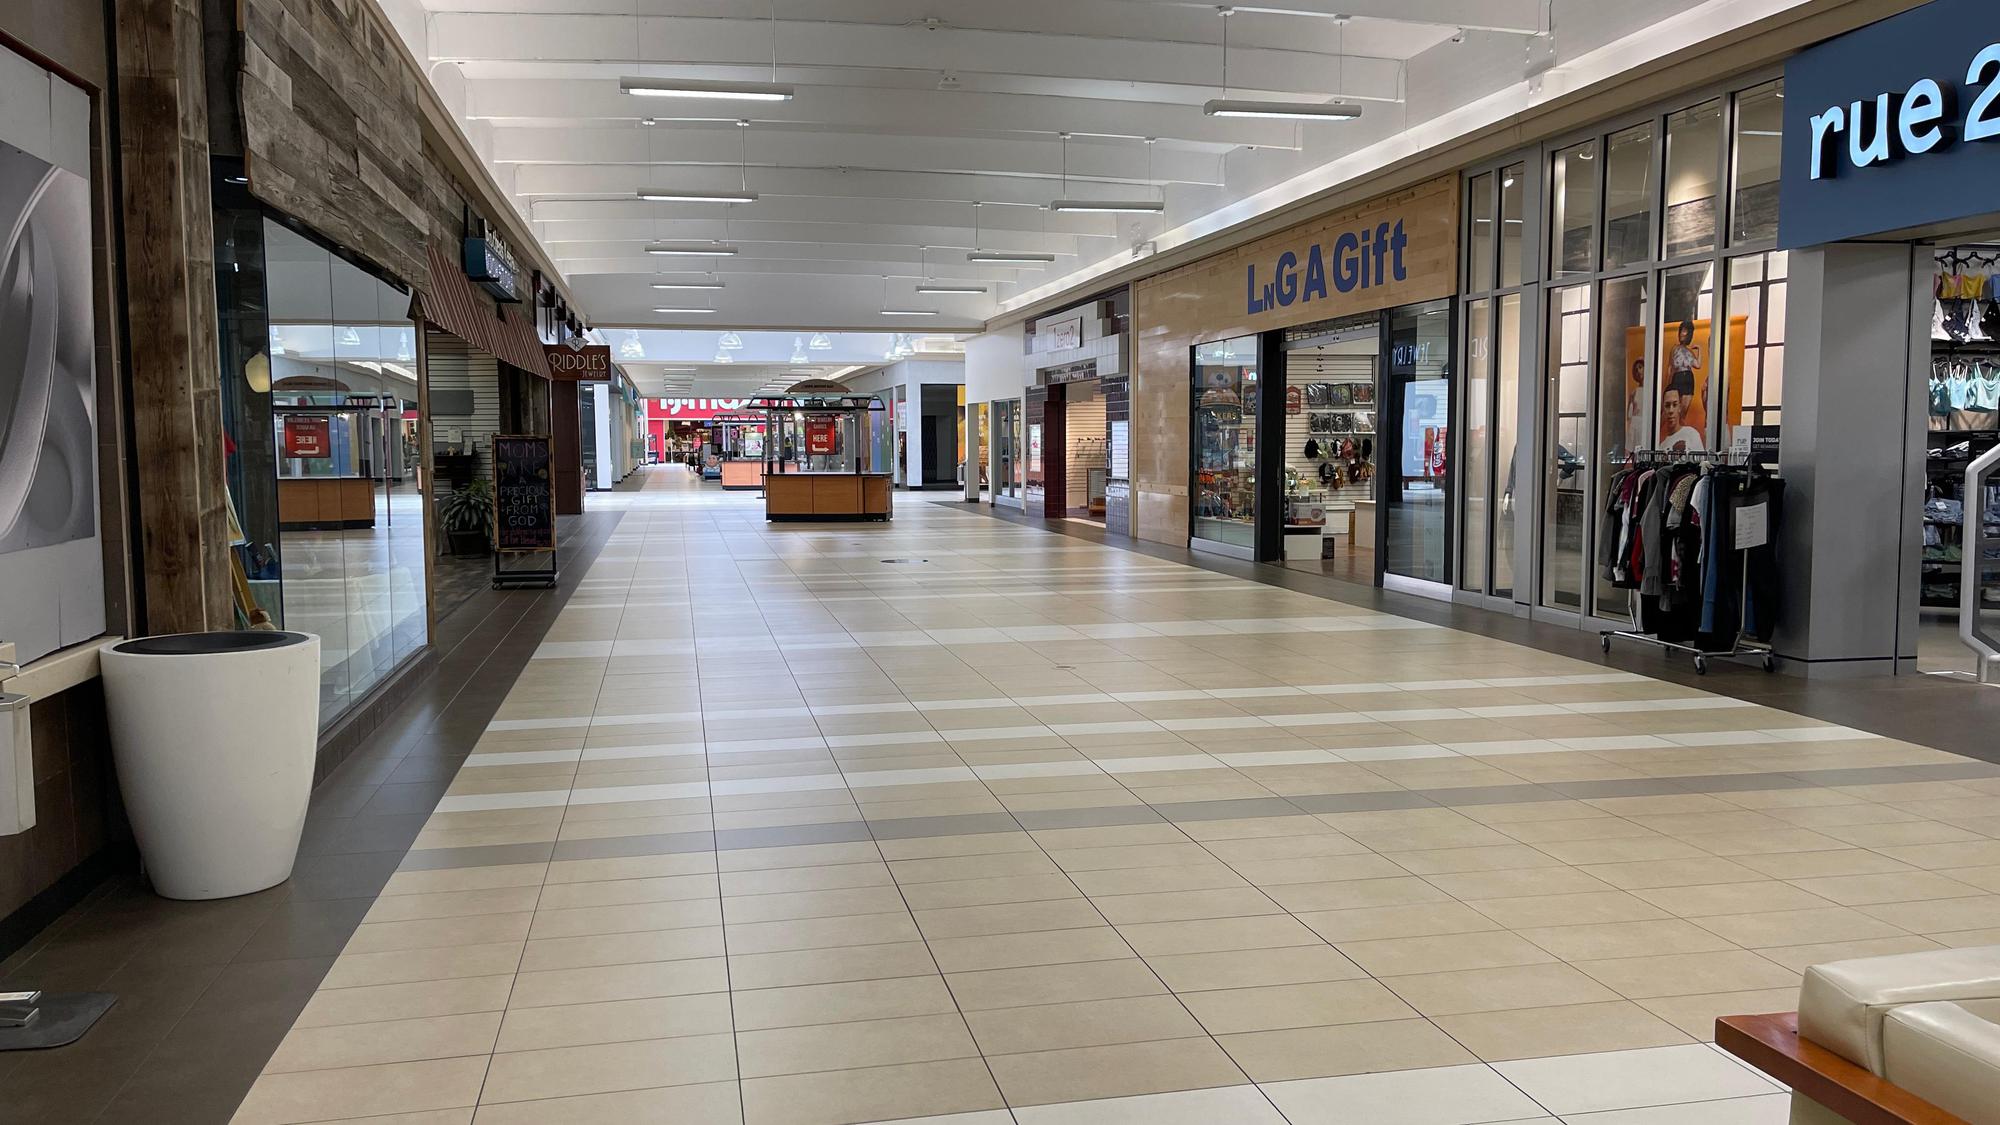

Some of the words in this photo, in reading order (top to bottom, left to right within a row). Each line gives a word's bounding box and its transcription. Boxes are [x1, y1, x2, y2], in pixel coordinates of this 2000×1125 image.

[1809, 78, 1943, 180] rue
[1302, 244, 1328, 303] A
[1332, 218, 1408, 293] Gift
[547, 353, 607, 373] RIDDLE'S
[812, 434, 828, 443] HERE
[499, 441, 548, 458] MOMS
[507, 460, 539, 476] ARE
[500, 485, 549, 497] PRECIOUS
[511, 495, 539, 506] GIFT
[506, 504, 538, 515] FROM
[508, 515, 537, 527] GOD
